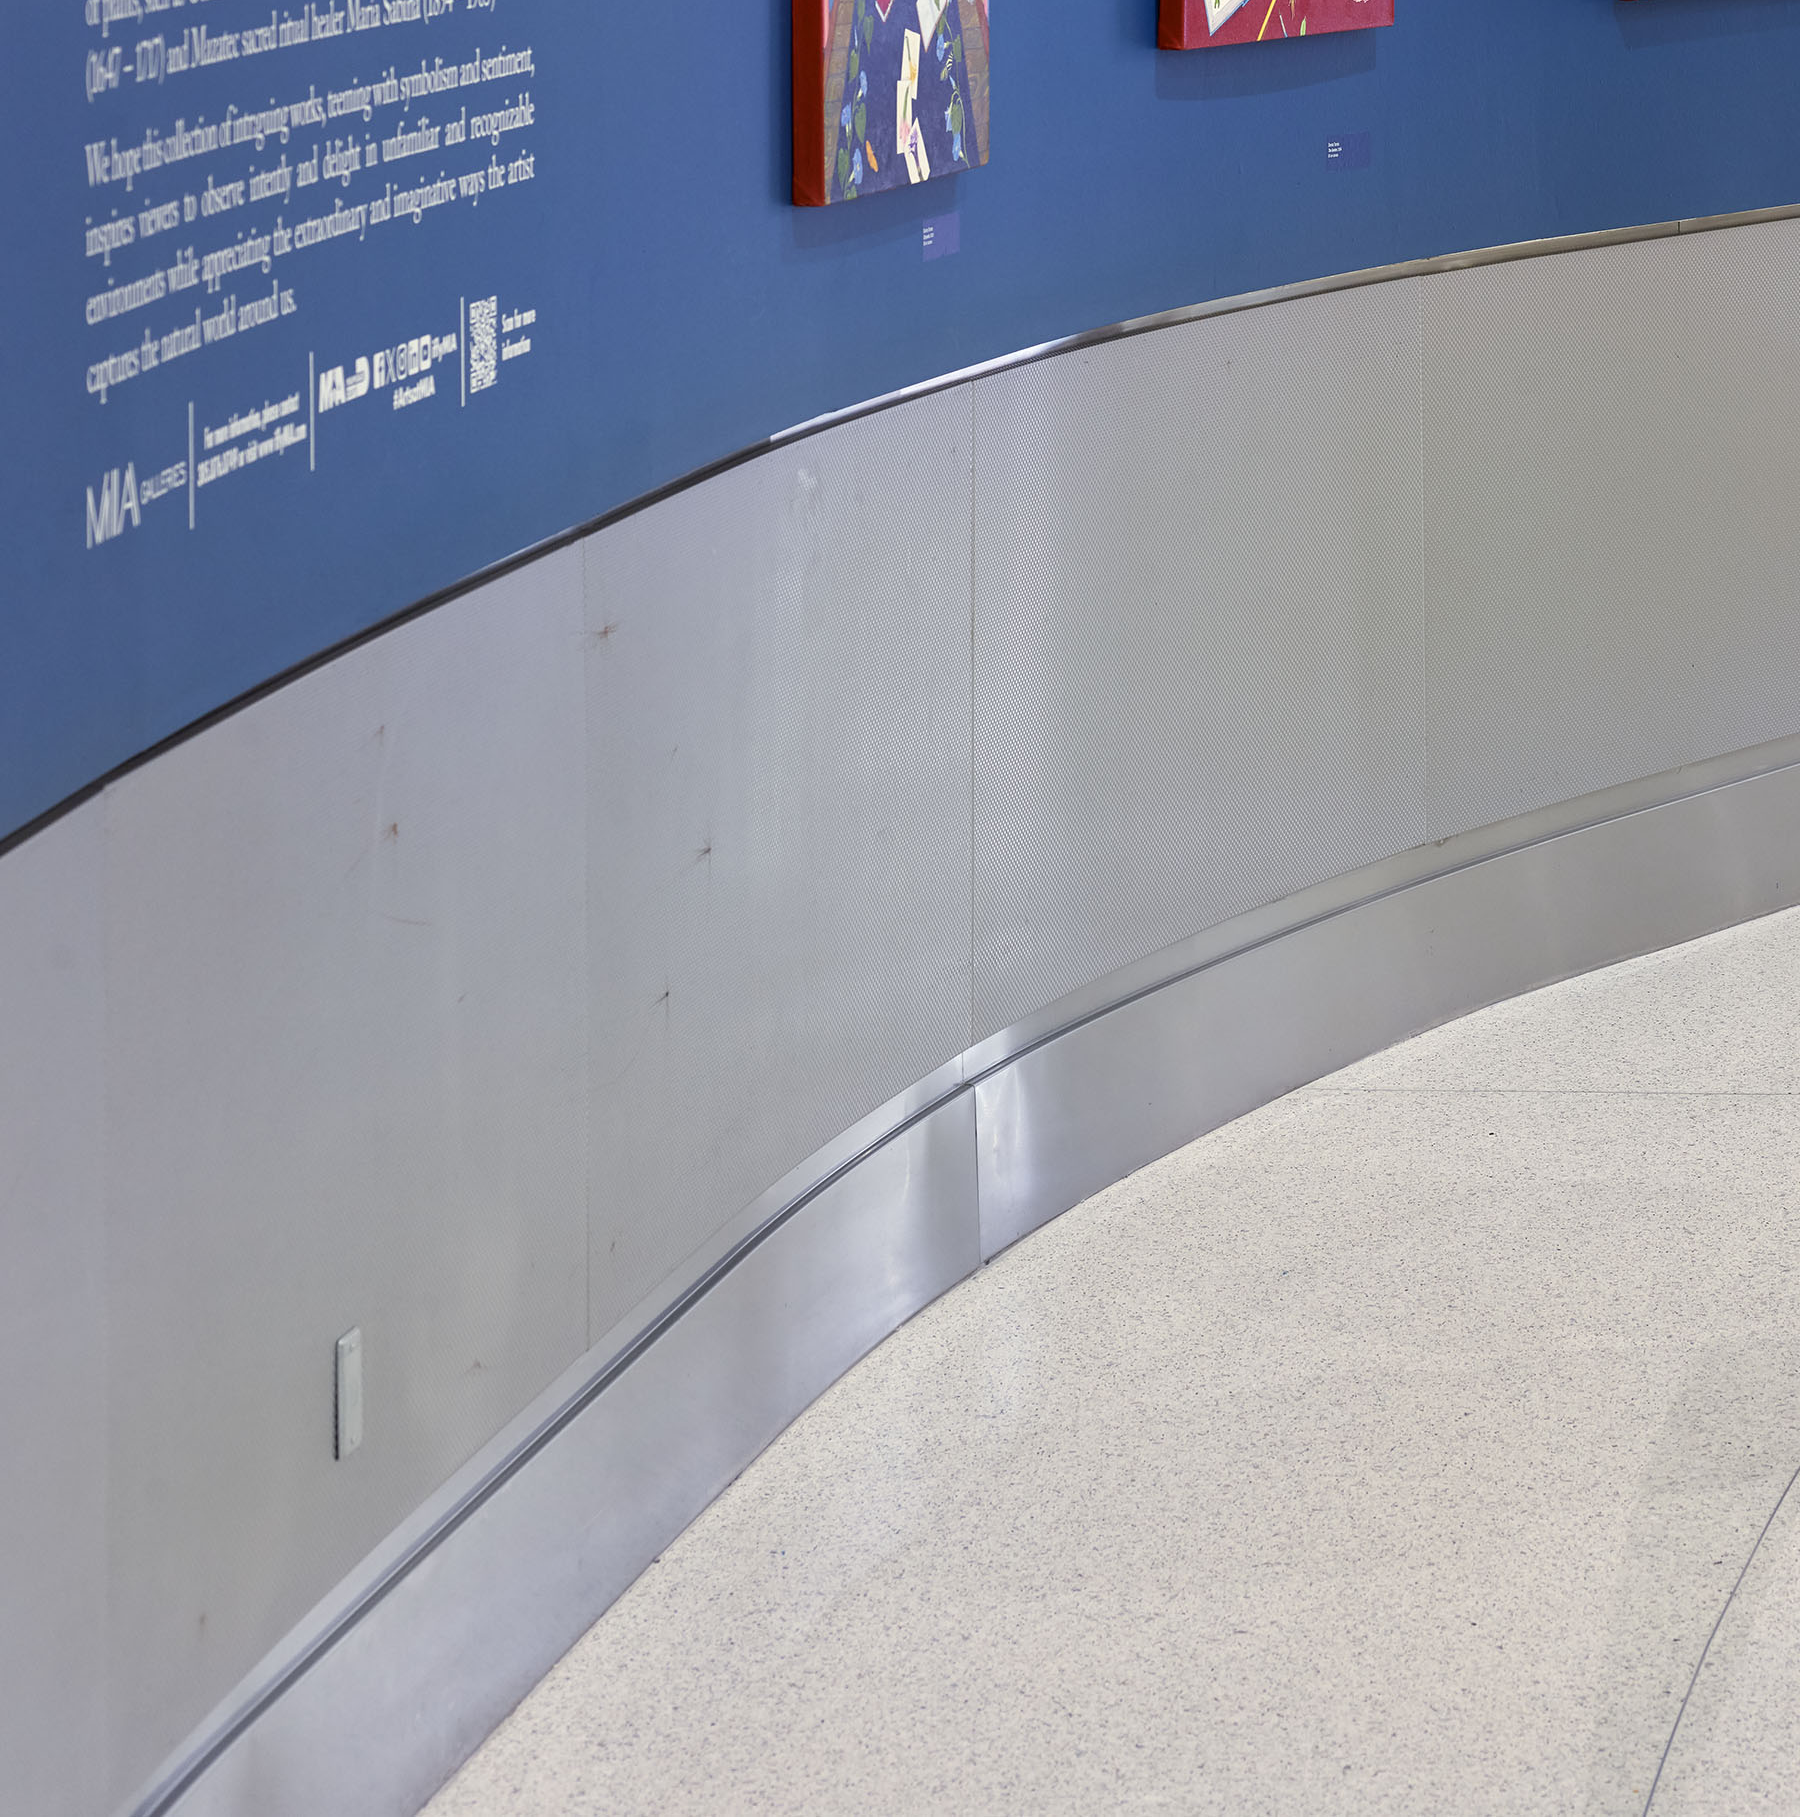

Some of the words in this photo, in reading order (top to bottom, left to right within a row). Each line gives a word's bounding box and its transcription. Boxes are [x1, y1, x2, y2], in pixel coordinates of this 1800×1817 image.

[326, 78, 372, 122] teeming
[372, 66, 398, 106] with
[400, 57, 458, 112] symbolism
[459, 48, 480, 86] and
[481, 46, 534, 81] sentiment,
[322, 135, 360, 187] delight
[364, 134, 378, 167] in
[382, 116, 440, 162] unfamiliar
[444, 107, 466, 146] and
[470, 92, 534, 146] recognizable
[294, 198, 367, 249] extraordinary
[369, 183, 391, 225] and
[393, 171, 456, 224] imaginative
[458, 170, 485, 206] ways
[488, 154, 505, 190] the
[507, 149, 534, 184] artist
[86, 462, 141, 549] MIA
